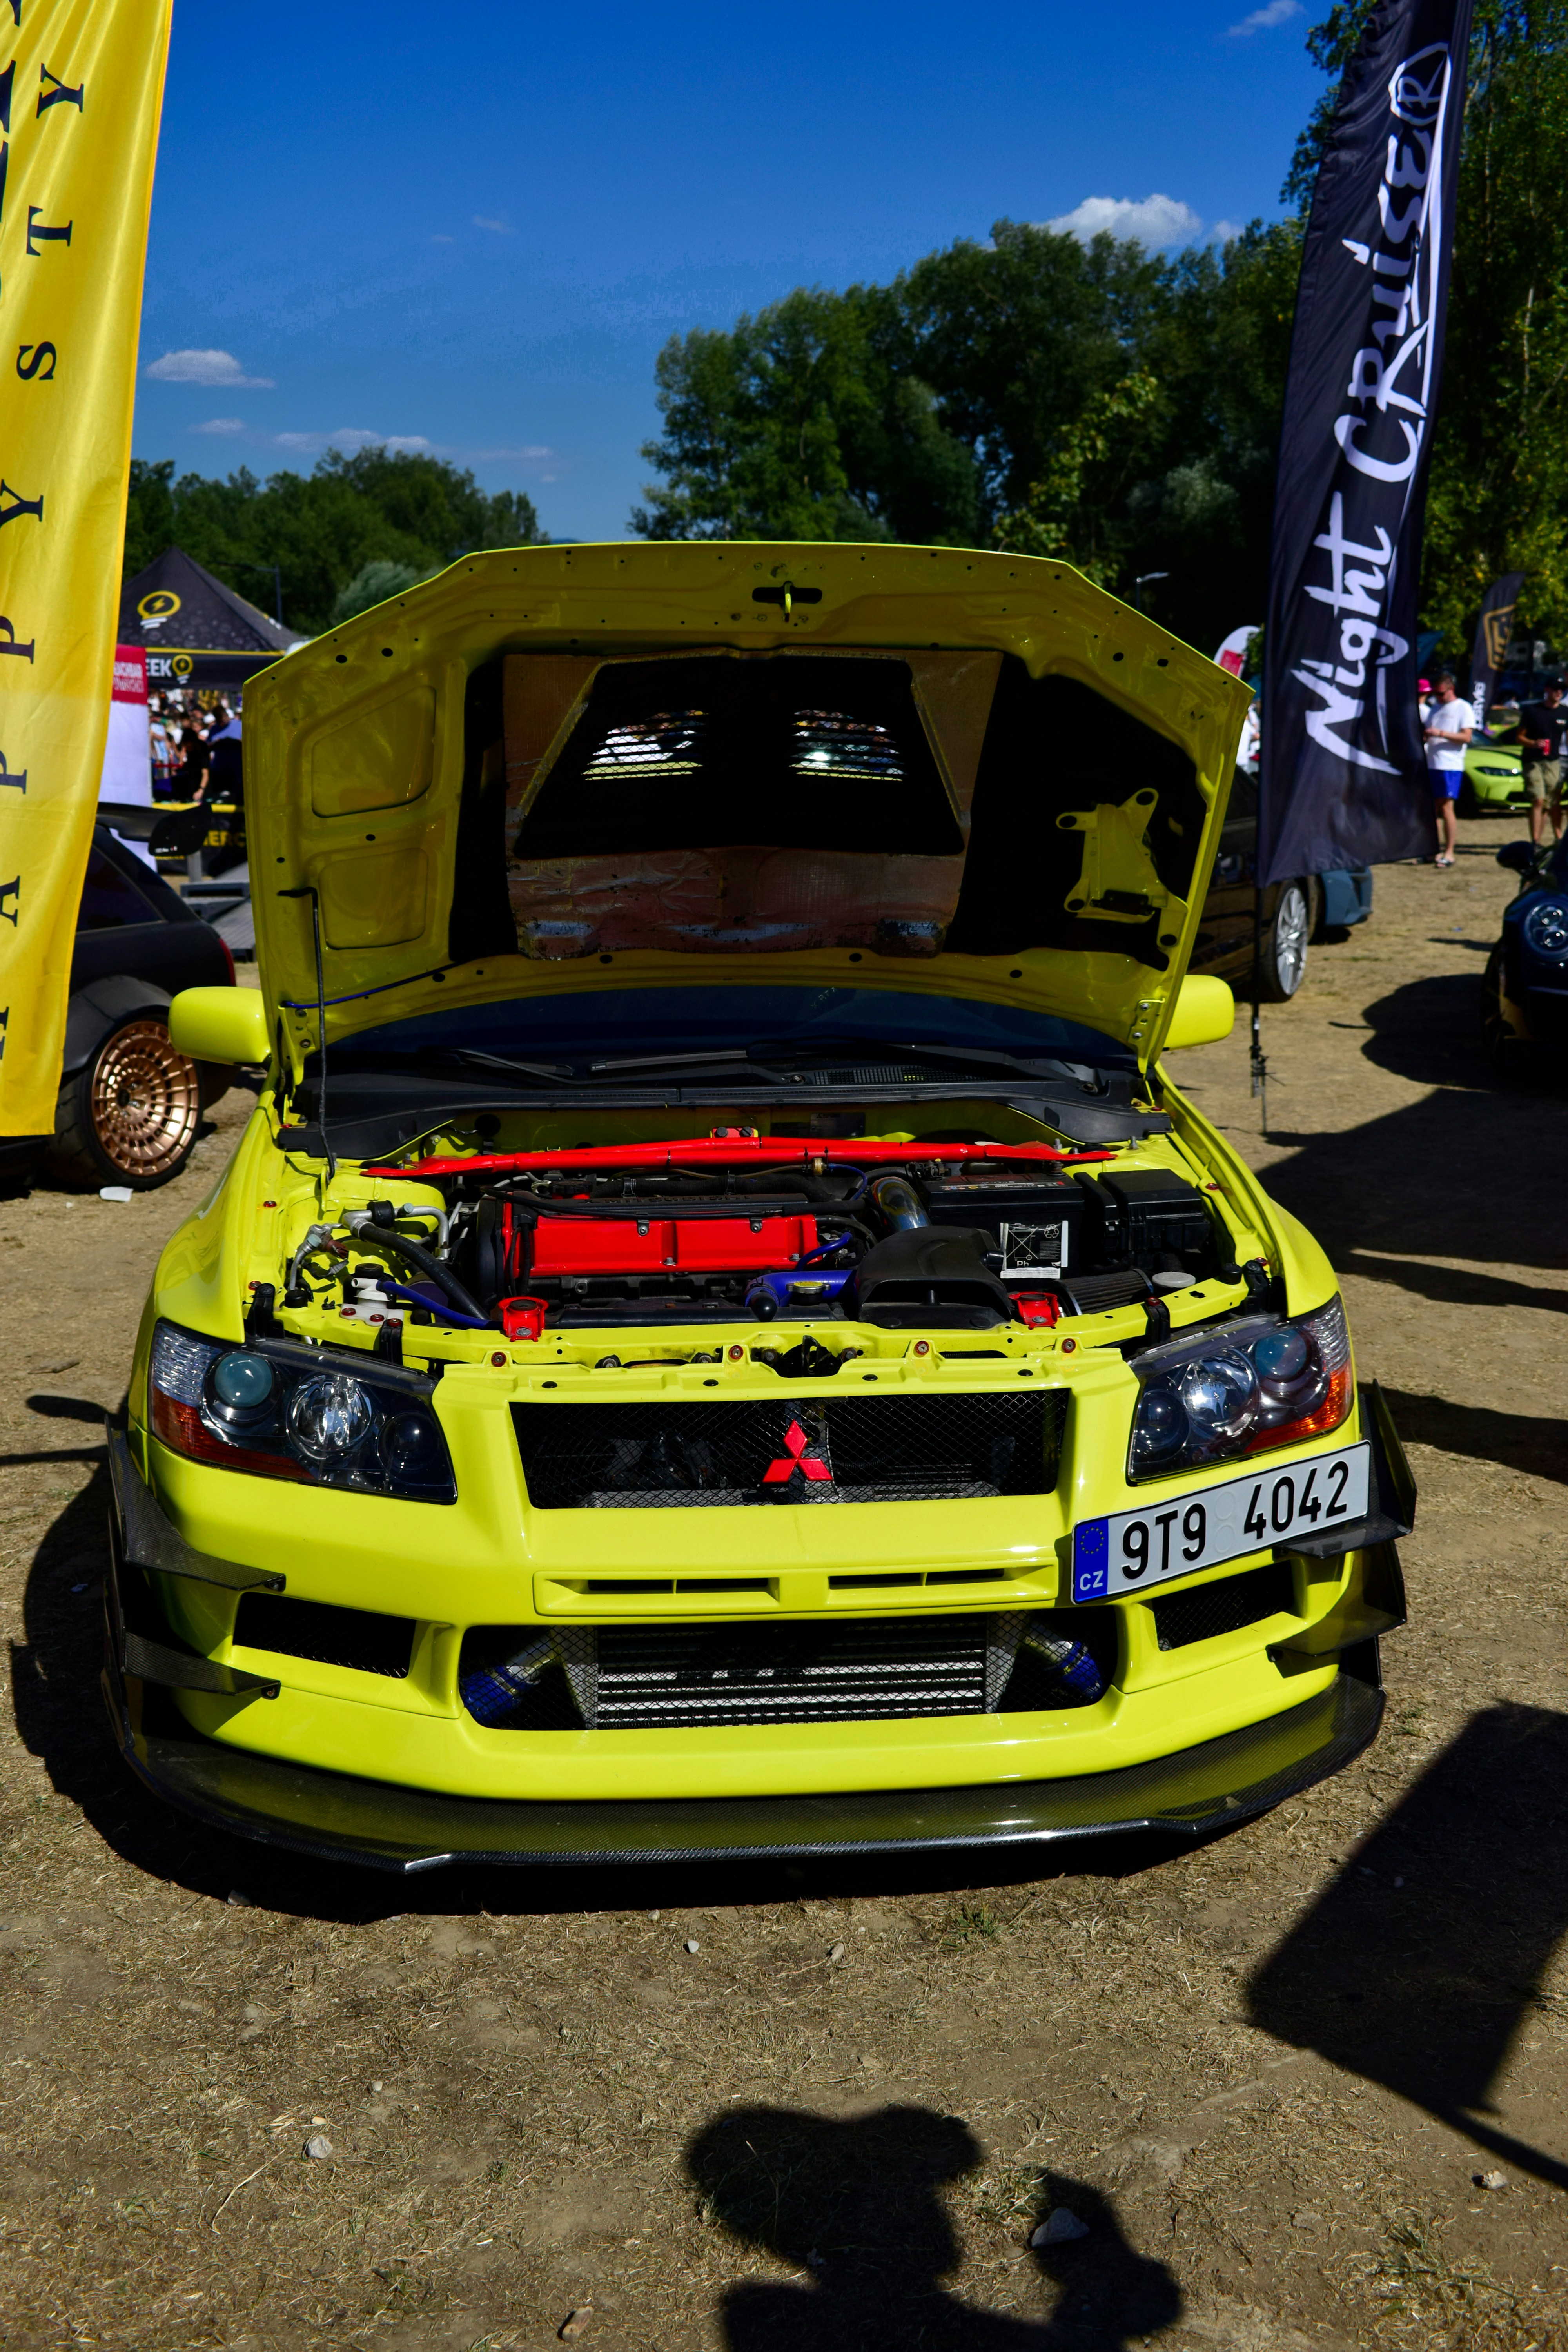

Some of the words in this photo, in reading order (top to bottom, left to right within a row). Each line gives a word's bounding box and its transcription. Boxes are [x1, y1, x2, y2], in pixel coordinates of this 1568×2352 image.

[1080, 1570, 1103, 1591] CZ
[1121, 1503, 1207, 1580] 9T9
[1243, 1460, 1349, 1540] 4042
